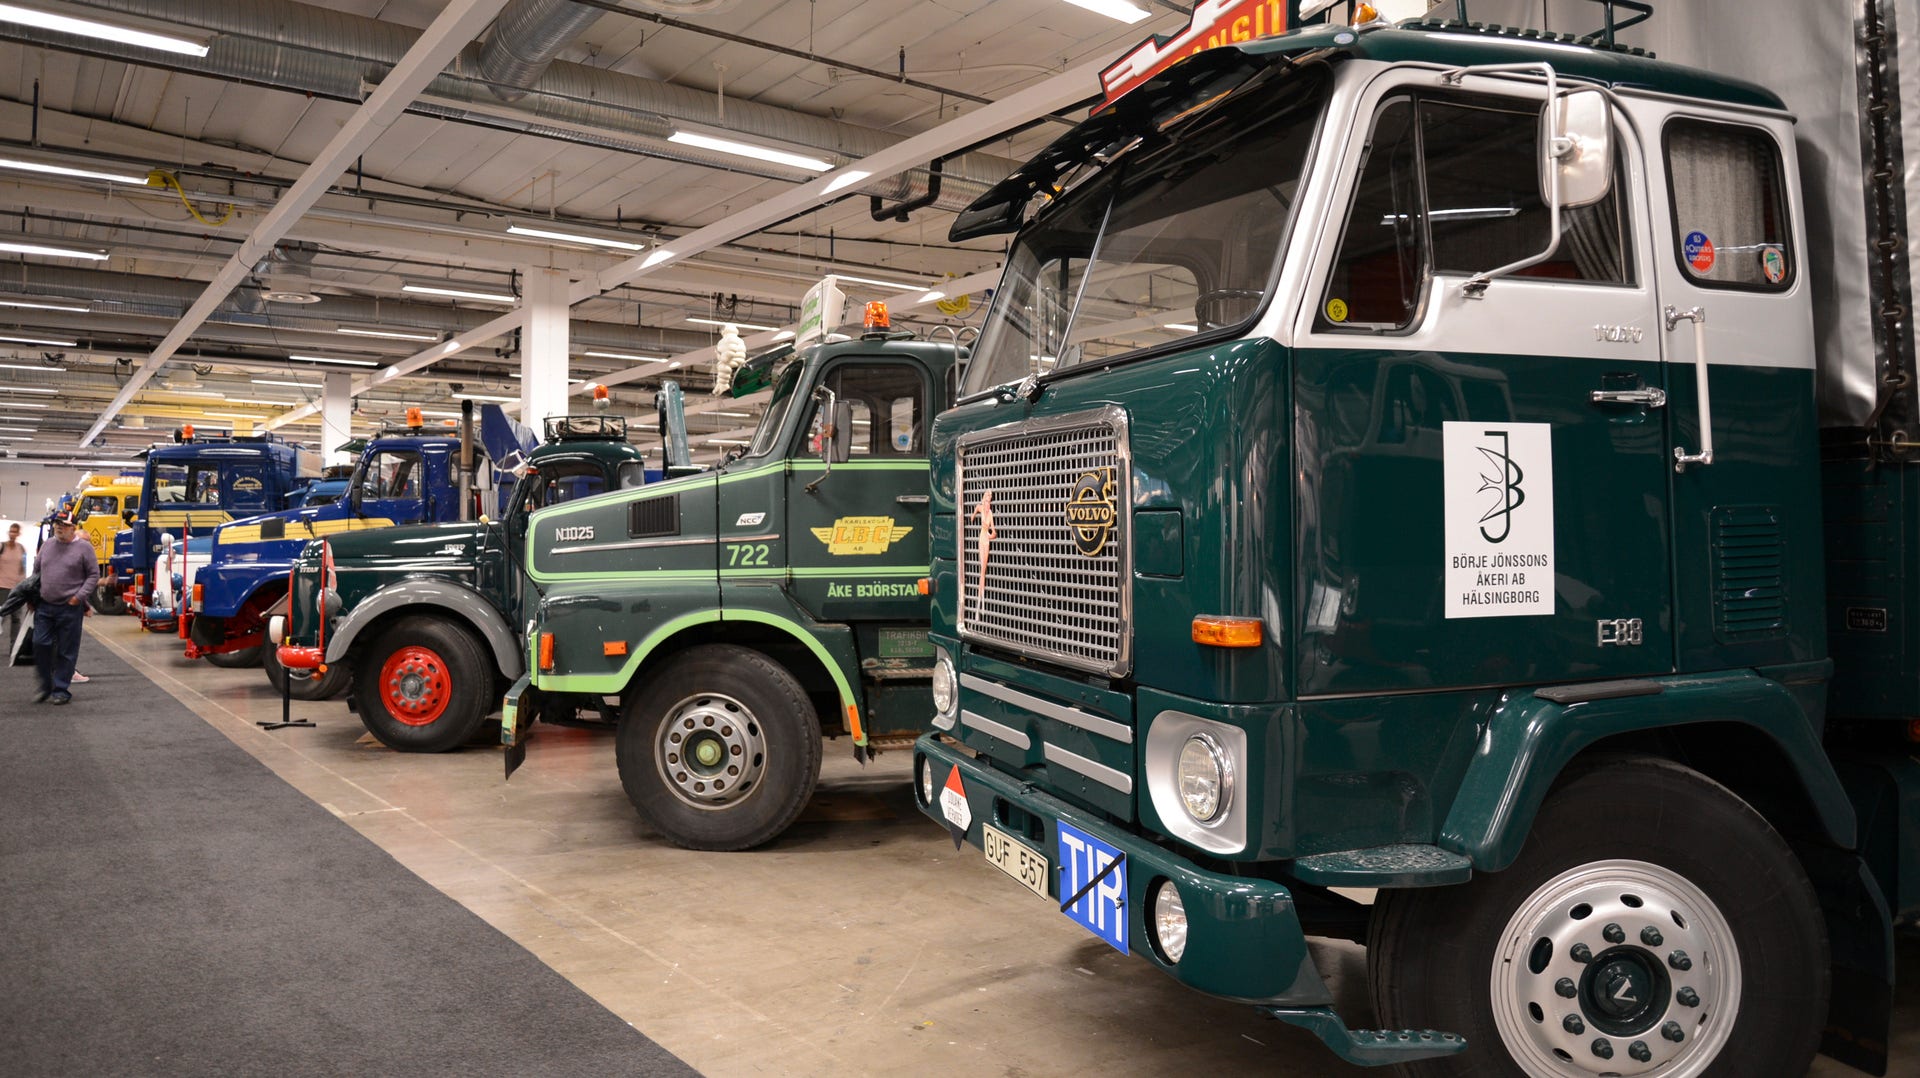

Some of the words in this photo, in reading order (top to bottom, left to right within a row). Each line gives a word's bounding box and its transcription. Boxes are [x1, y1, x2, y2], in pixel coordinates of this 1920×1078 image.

[1068, 507, 1110, 521] VOLVO
[555, 526, 594, 541] N1025
[834, 526, 889, 544] LBC
[726, 544, 769, 566] 722
[1453, 552, 1488, 569] BÖRJE
[1491, 552, 1548, 568] JÖNSSONS
[1476, 571, 1508, 586] ÅKERI
[1512, 572, 1526, 586] AB
[827, 582, 852, 597] ÅKE
[1462, 589, 1540, 606] HÄLSINGBORG
[986, 832, 1010, 866] GUF
[1020, 850, 1045, 890] 557
[1061, 831, 1123, 943] TIR
